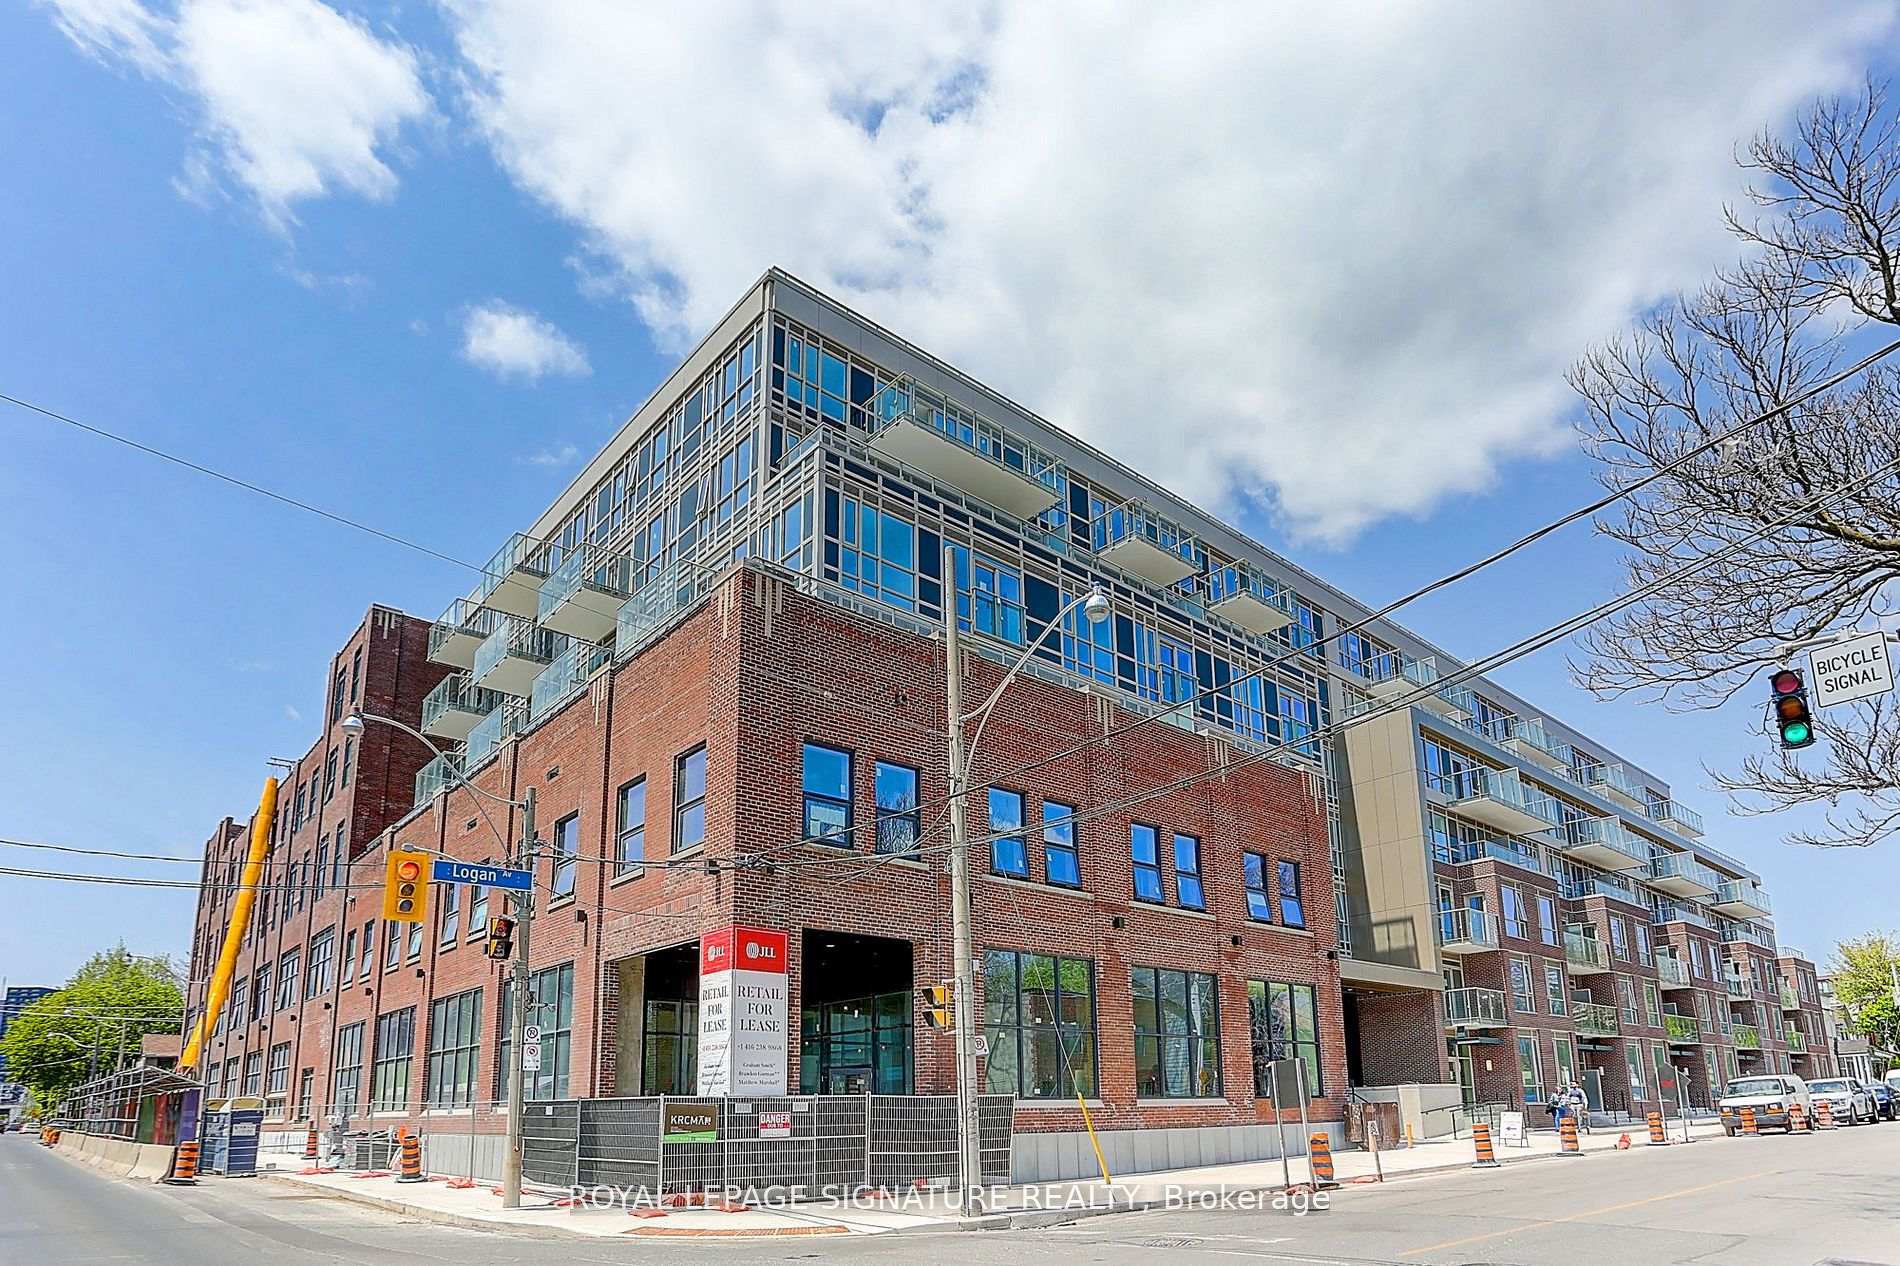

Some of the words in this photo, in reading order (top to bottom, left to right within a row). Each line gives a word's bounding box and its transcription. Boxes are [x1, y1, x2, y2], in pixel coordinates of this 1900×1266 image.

[1816, 645, 1883, 676] BICYCLE
[1824, 667, 1883, 693] SIGNAL
[452, 863, 497, 883] Logan
[502, 870, 512, 878] Av
[759, 946, 777, 958] JLL
[702, 985, 729, 1001] RETAIL
[737, 985, 784, 1000] RETAIL
[707, 1002, 723, 1017] FOR
[747, 1002, 773, 1016] FOR
[703, 1019, 727, 1033] LEASE
[740, 1018, 780, 1033] LEASE
[760, 1114, 790, 1124] DANGER
